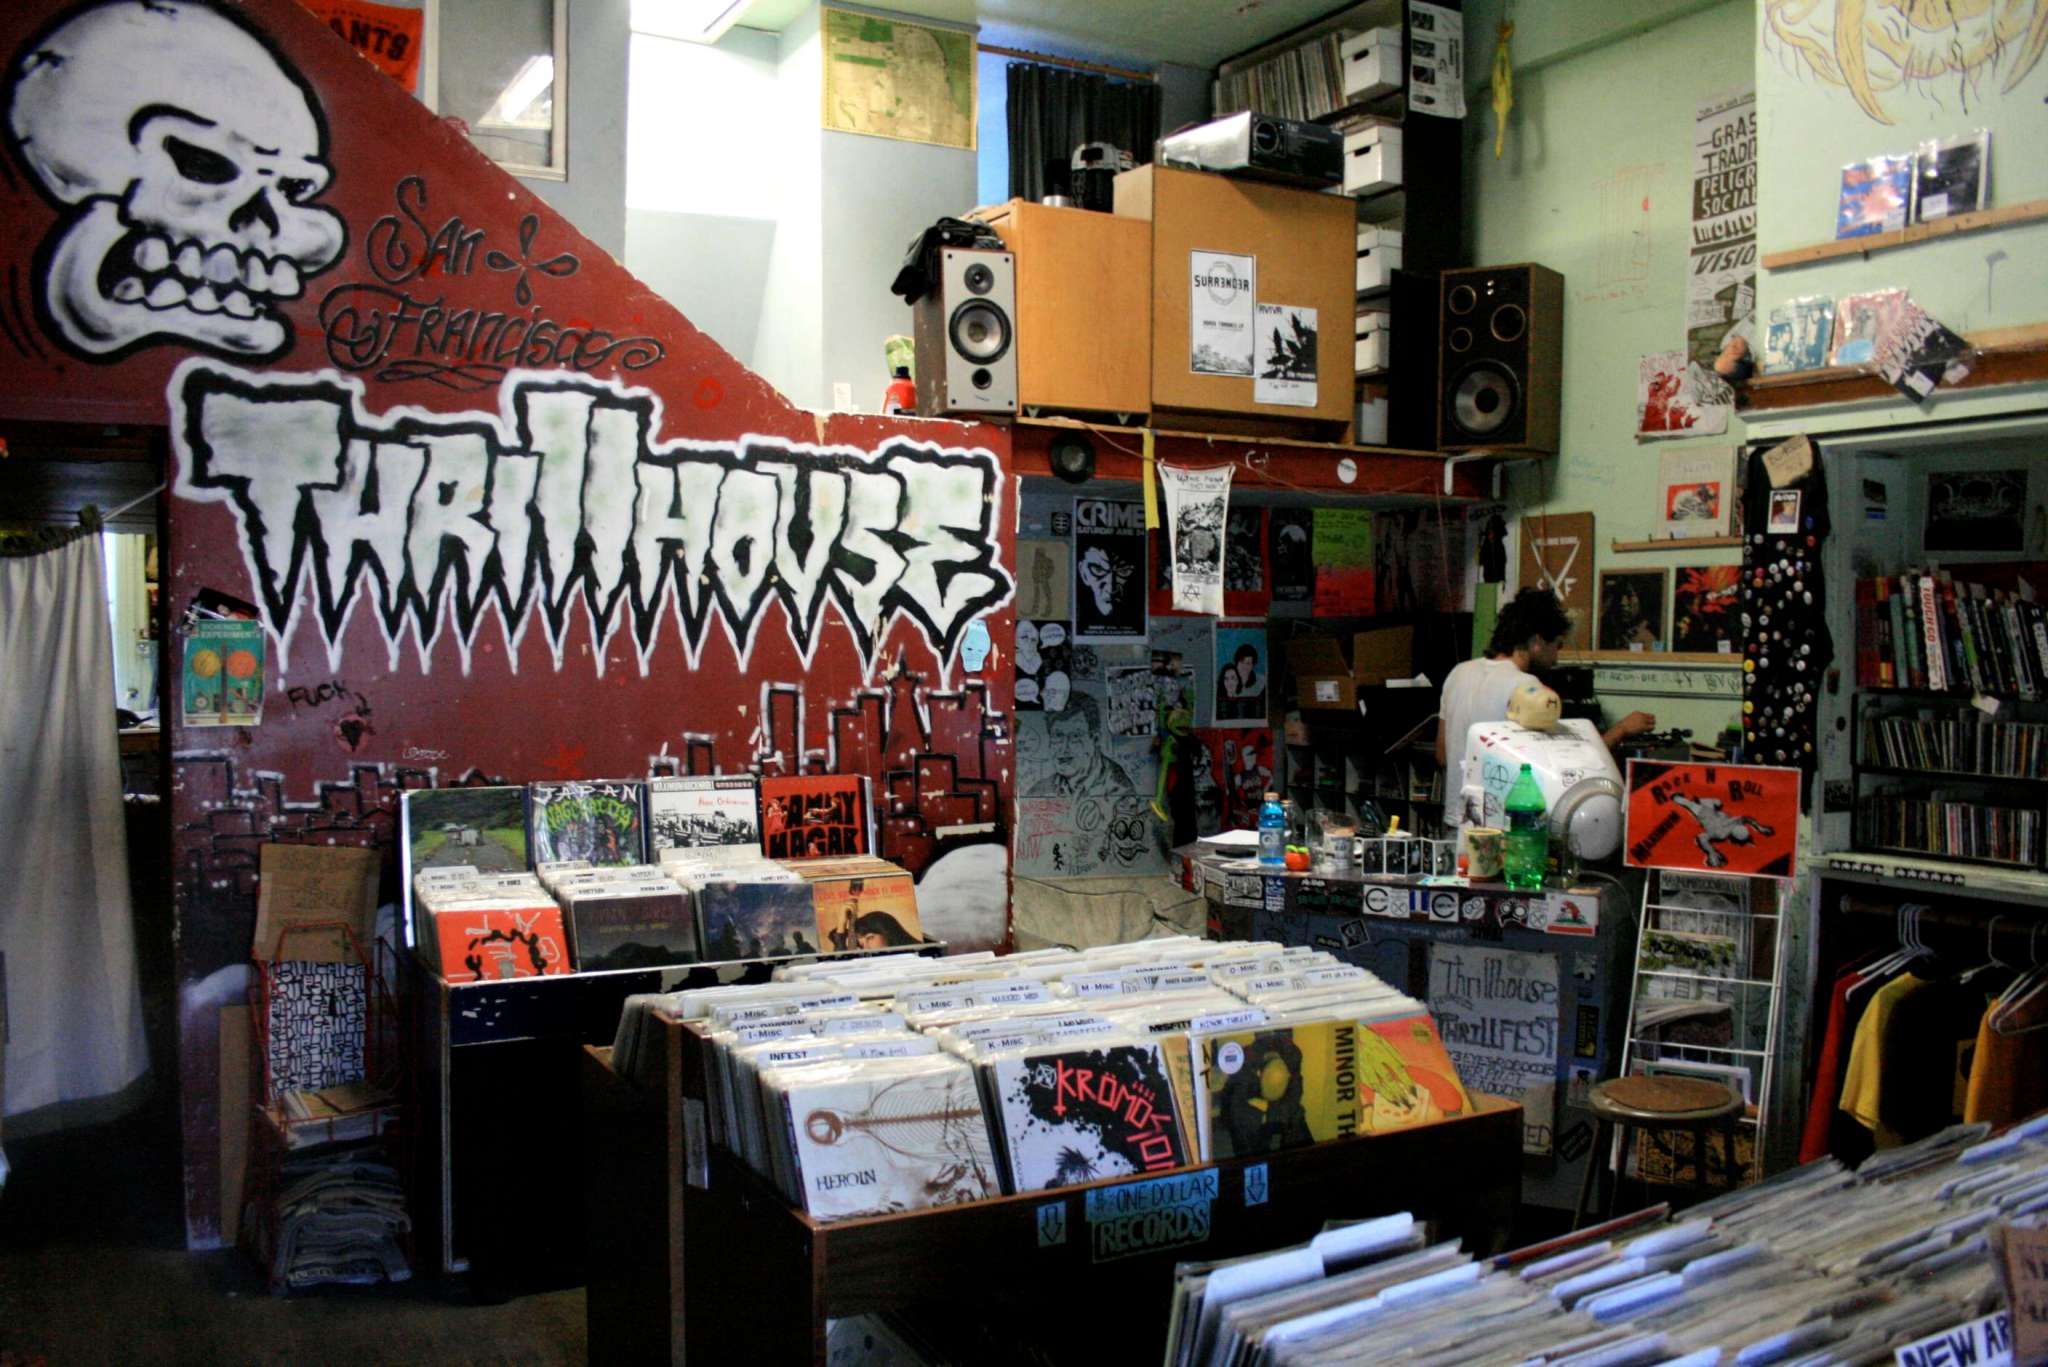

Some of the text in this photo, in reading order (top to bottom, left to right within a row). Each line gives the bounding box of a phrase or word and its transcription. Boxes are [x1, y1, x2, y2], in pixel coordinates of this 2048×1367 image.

[1078, 500, 1144, 529] CRIME
[288, 680, 349, 709] FUCK
[532, 785, 638, 805] JAPAN
[1727, 779, 1763, 802] ROLL
[769, 826, 859, 859] HAGAR
[769, 1051, 809, 1062] INFEST
[1334, 1026, 1353, 1104] MINOR
[817, 1168, 877, 1192] HEROIN
[1115, 1187, 1149, 1213] ONE
[1150, 1173, 1217, 1206] DOLLAR
[1099, 1203, 1208, 1257] RECORDS
[1902, 1327, 1978, 1367] NEW
